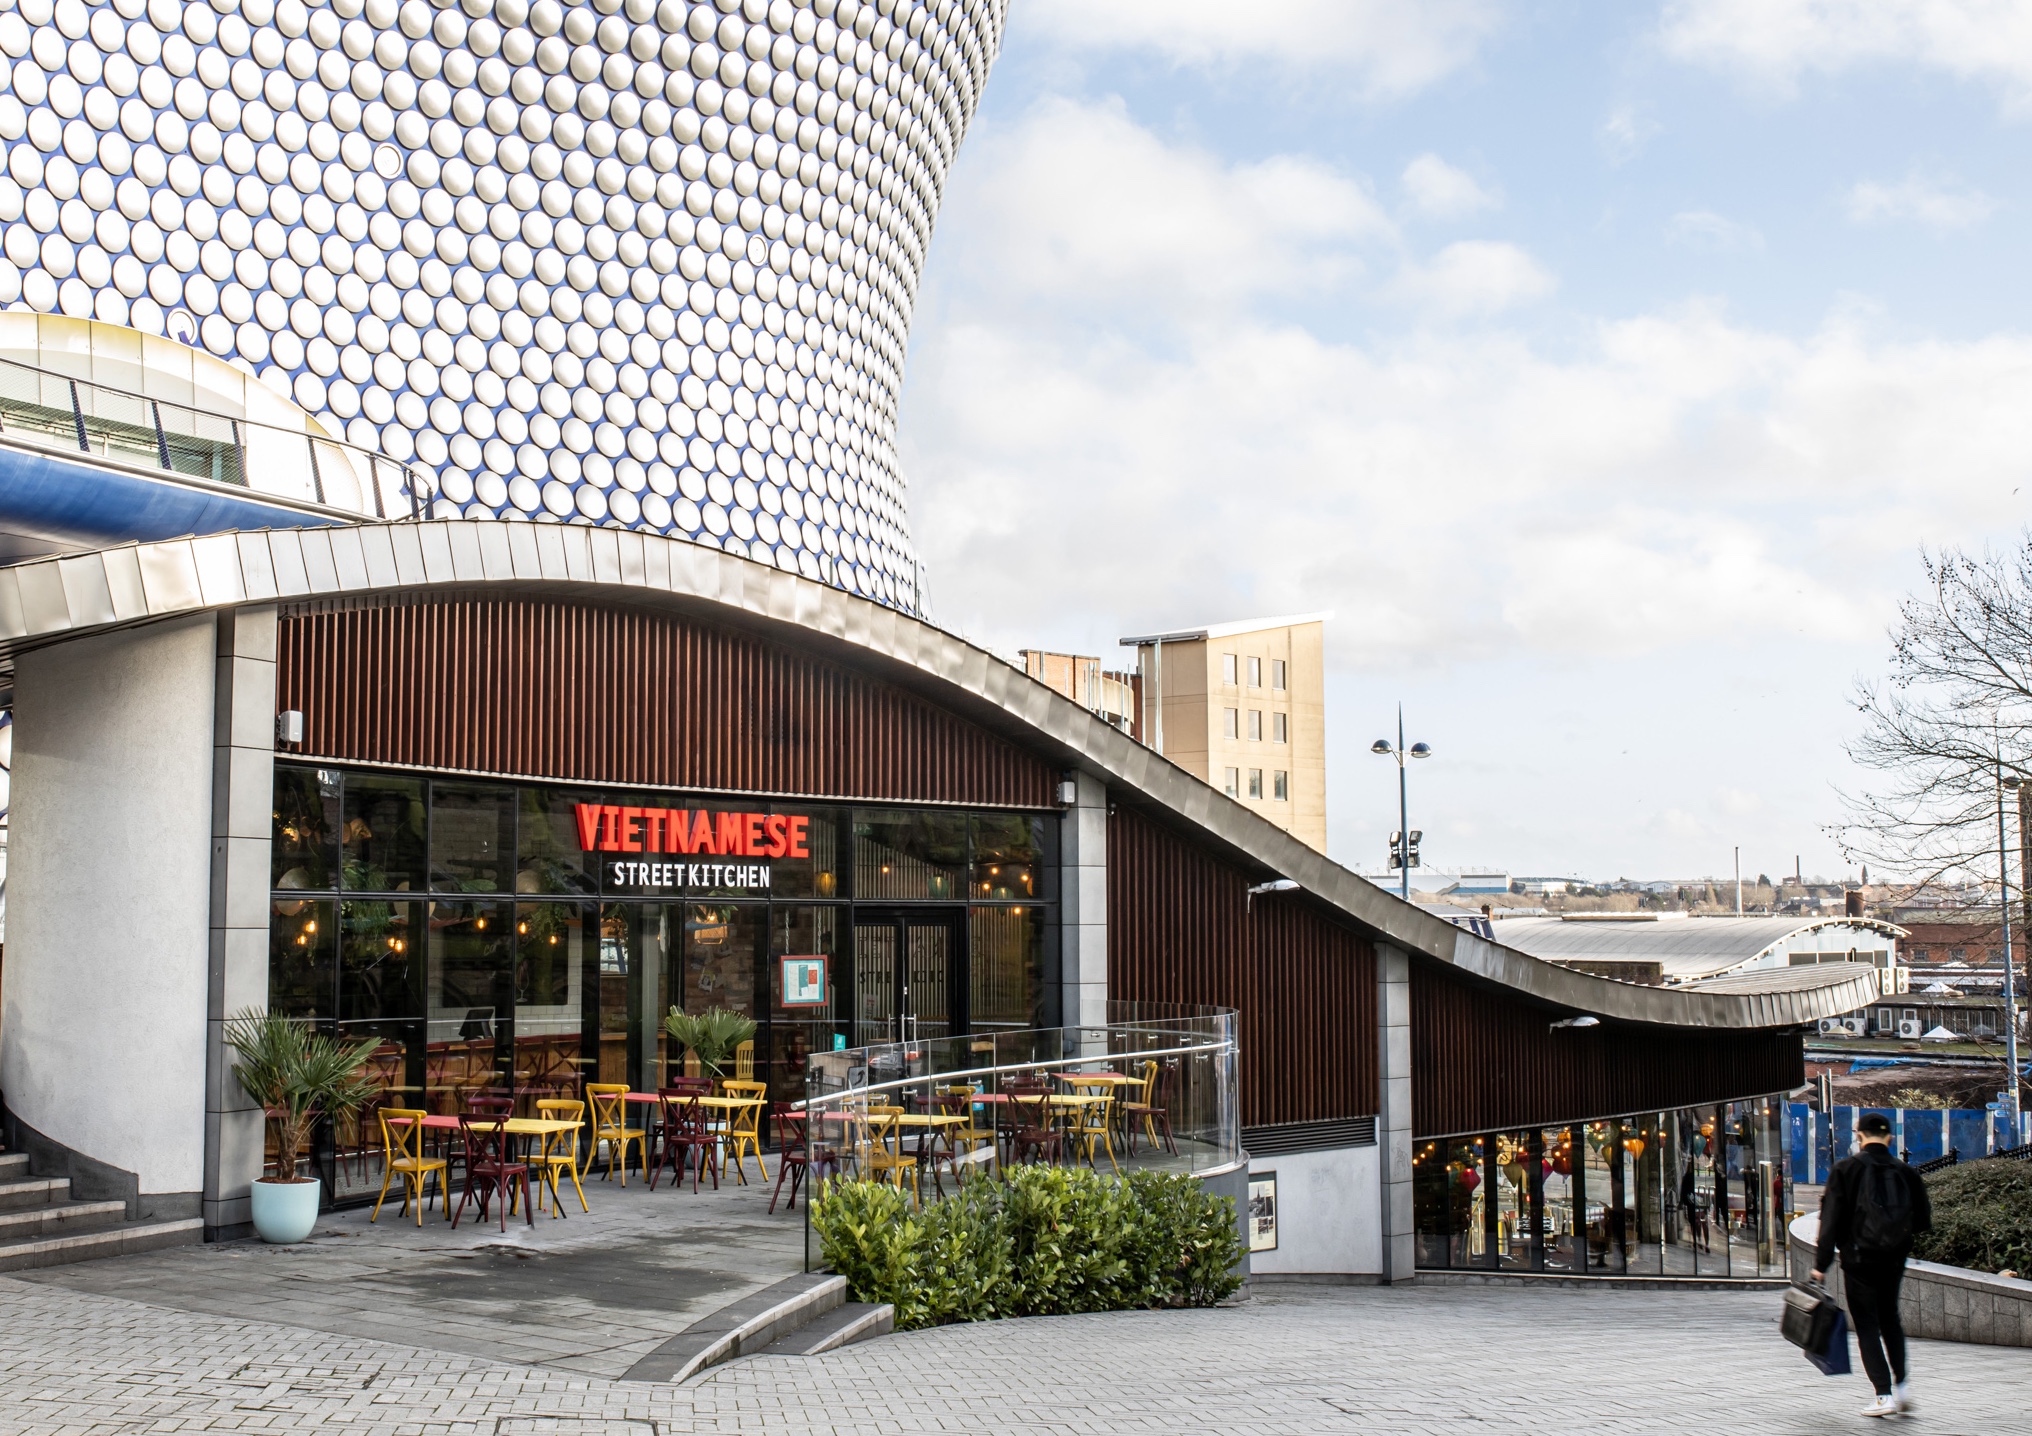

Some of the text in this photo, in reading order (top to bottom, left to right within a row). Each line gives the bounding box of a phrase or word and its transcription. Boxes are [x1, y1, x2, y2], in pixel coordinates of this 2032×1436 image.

[575, 803, 809, 858] VIETNAMESE
[614, 862, 770, 888] STREET KITCHEN
